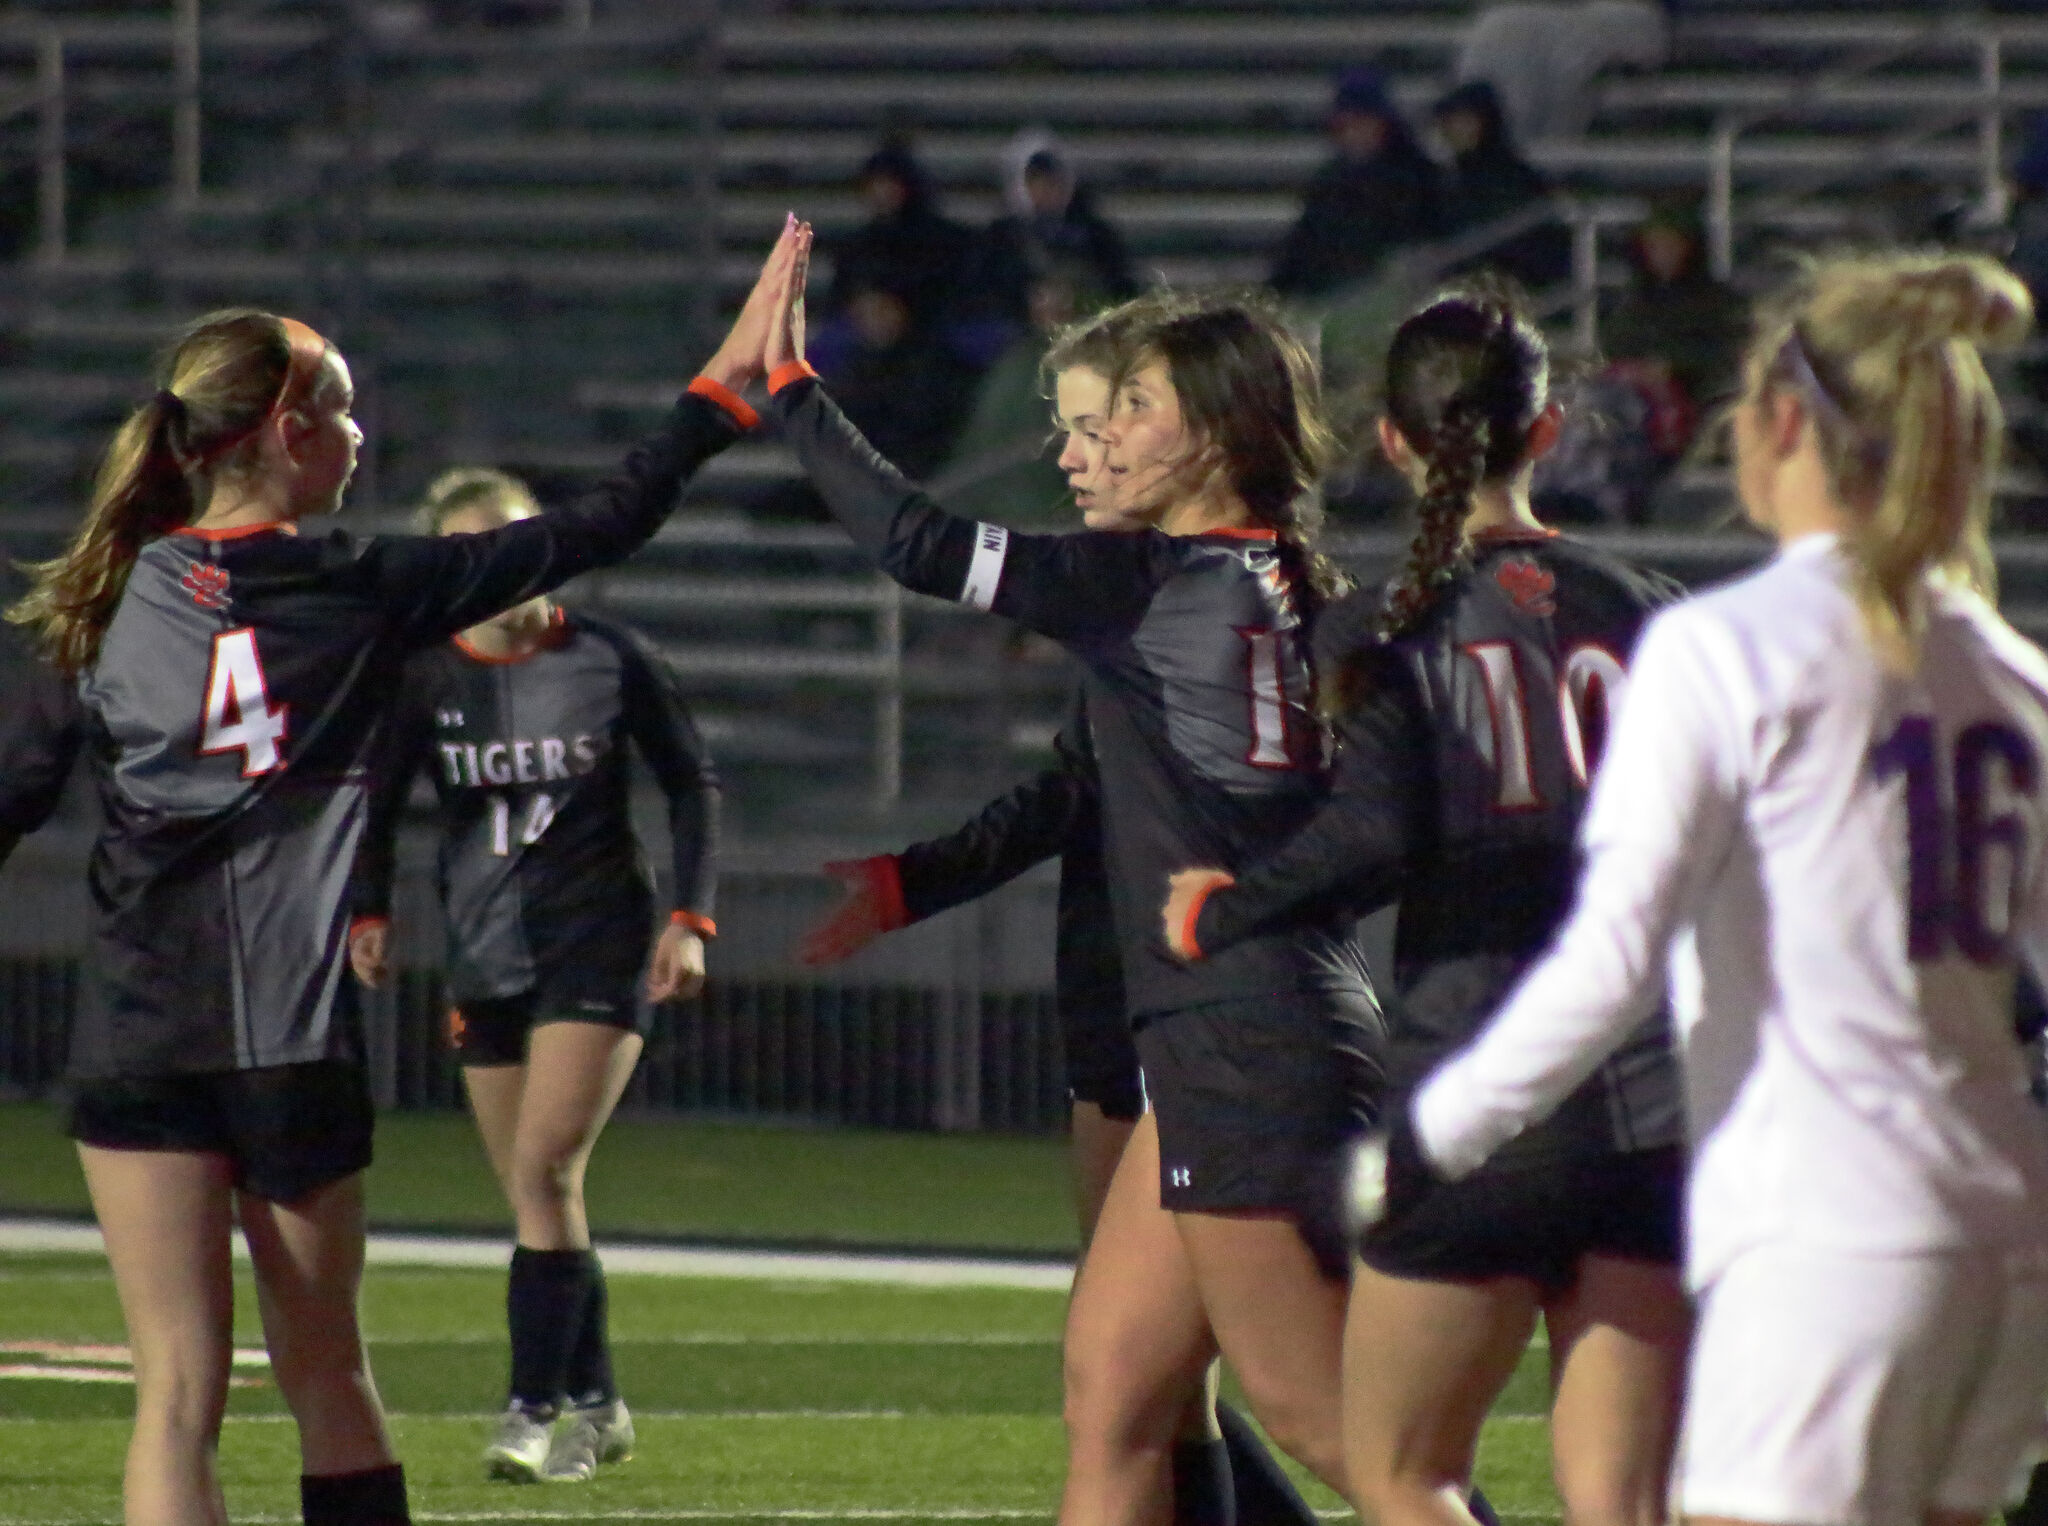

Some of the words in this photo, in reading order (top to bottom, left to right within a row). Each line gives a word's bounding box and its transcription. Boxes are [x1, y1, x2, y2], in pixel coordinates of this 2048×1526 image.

[196, 626, 288, 778] 4
[441, 734, 596, 786] TIGERS
[1232, 626, 1322, 768] 1
[1871, 713, 2040, 967] 16
